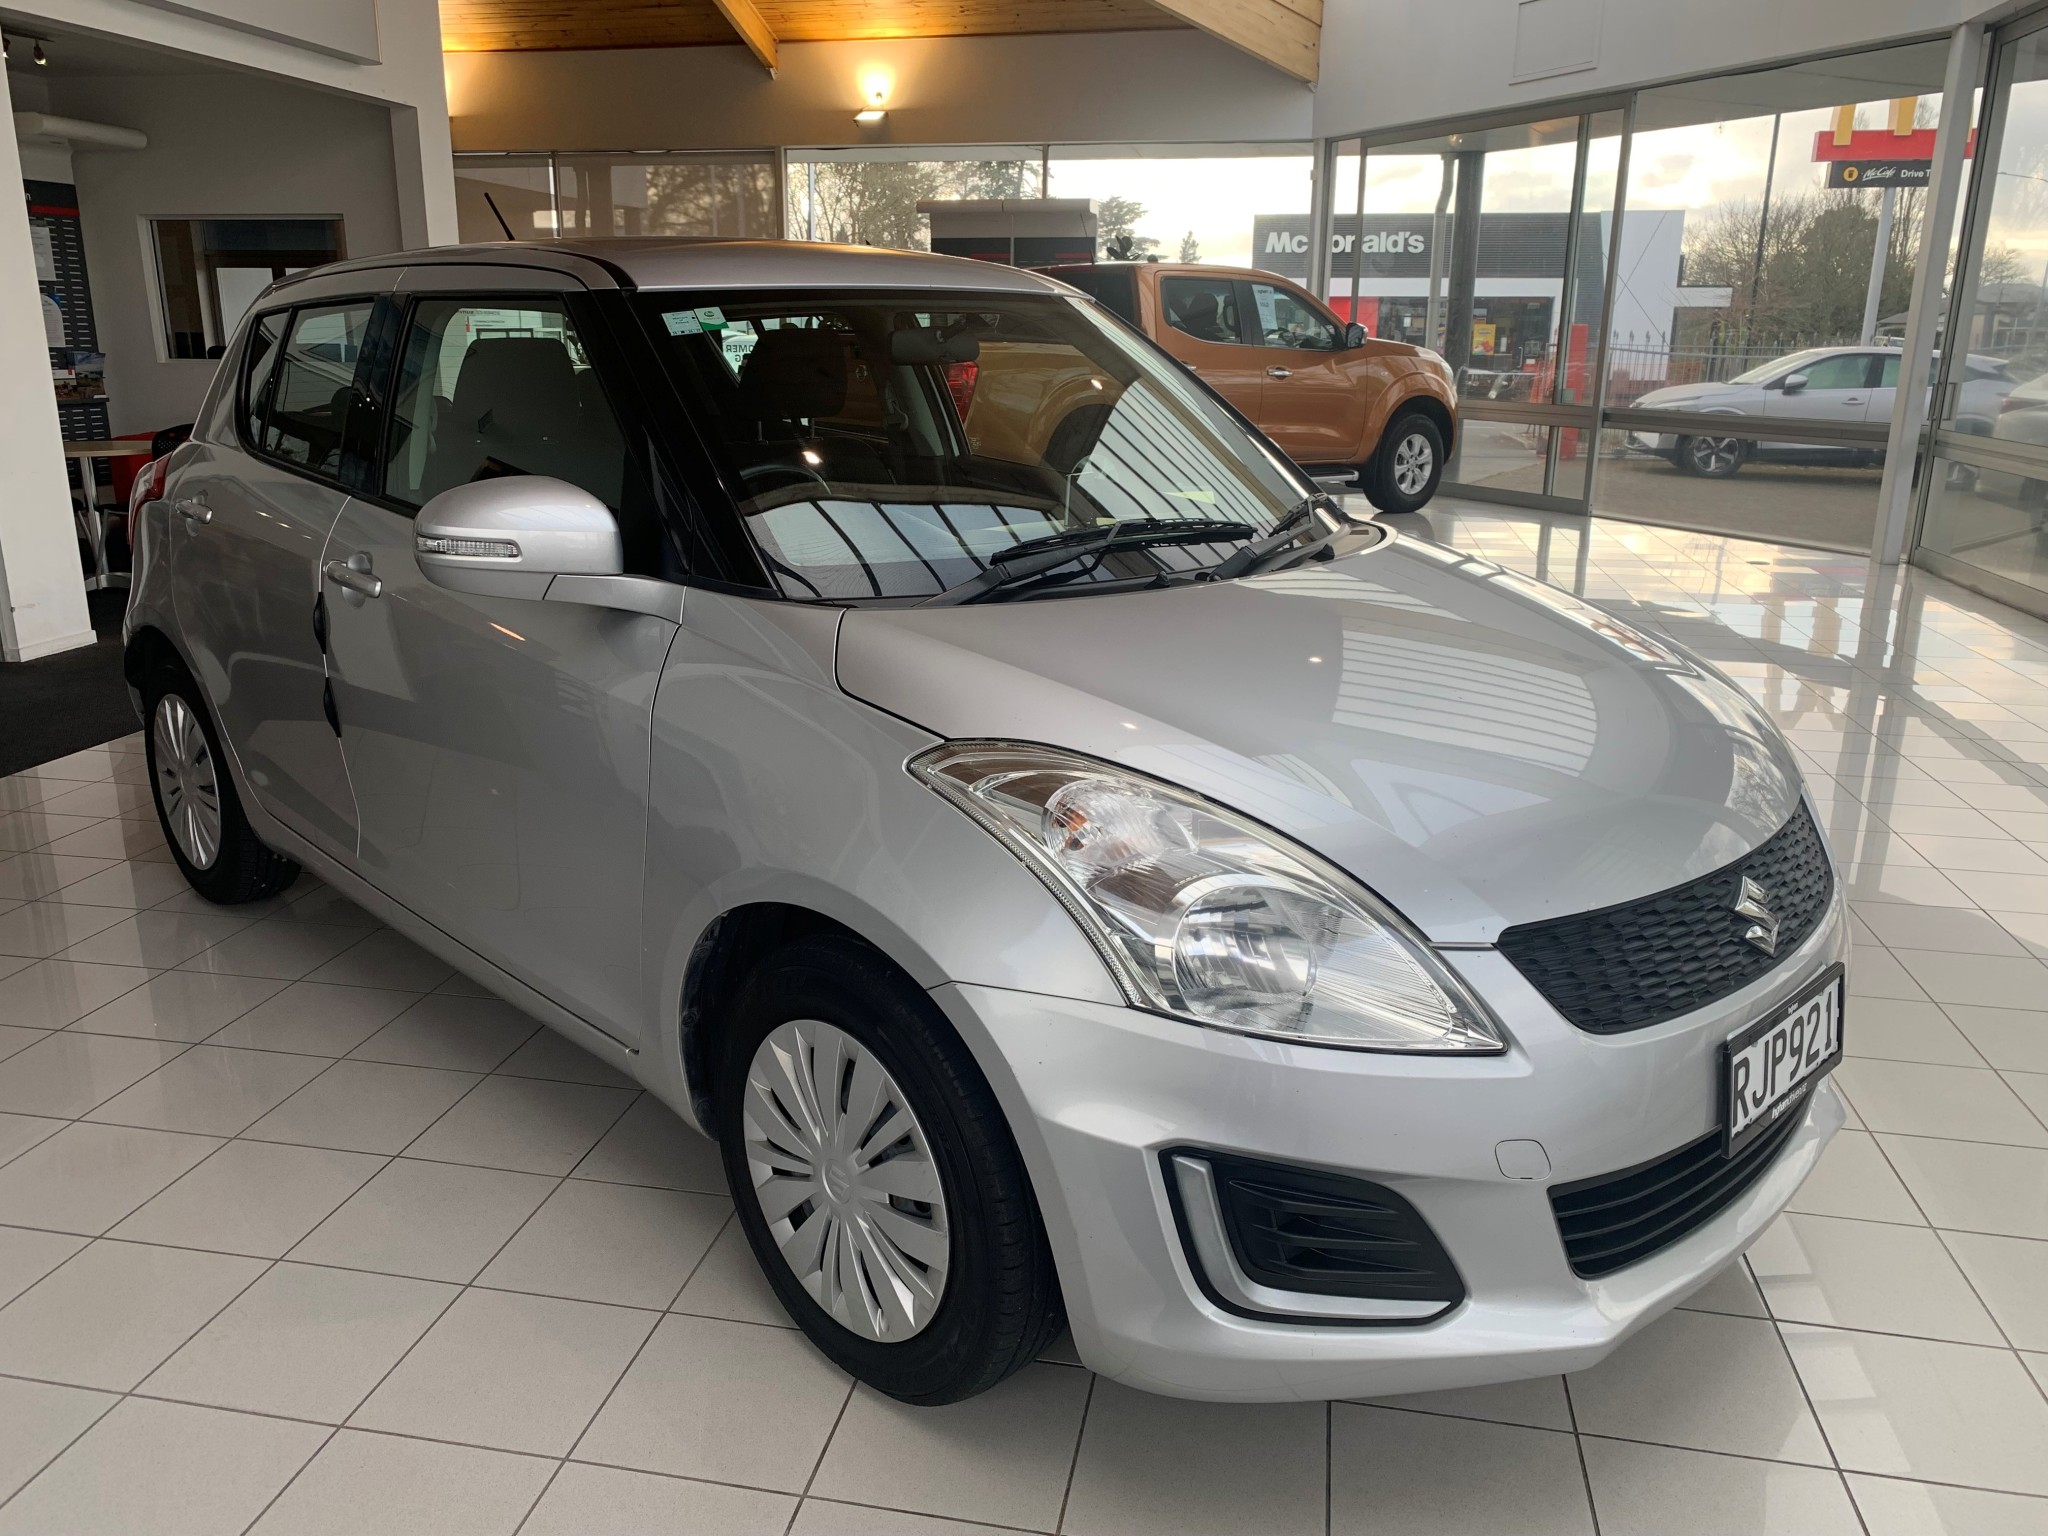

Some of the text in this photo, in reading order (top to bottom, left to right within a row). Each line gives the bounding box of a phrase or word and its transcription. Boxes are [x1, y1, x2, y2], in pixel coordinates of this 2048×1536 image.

[1901, 169, 1925, 178] Drive
[1264, 231, 1425, 254] Mconald's
[1732, 990, 1834, 1128] RJP921
